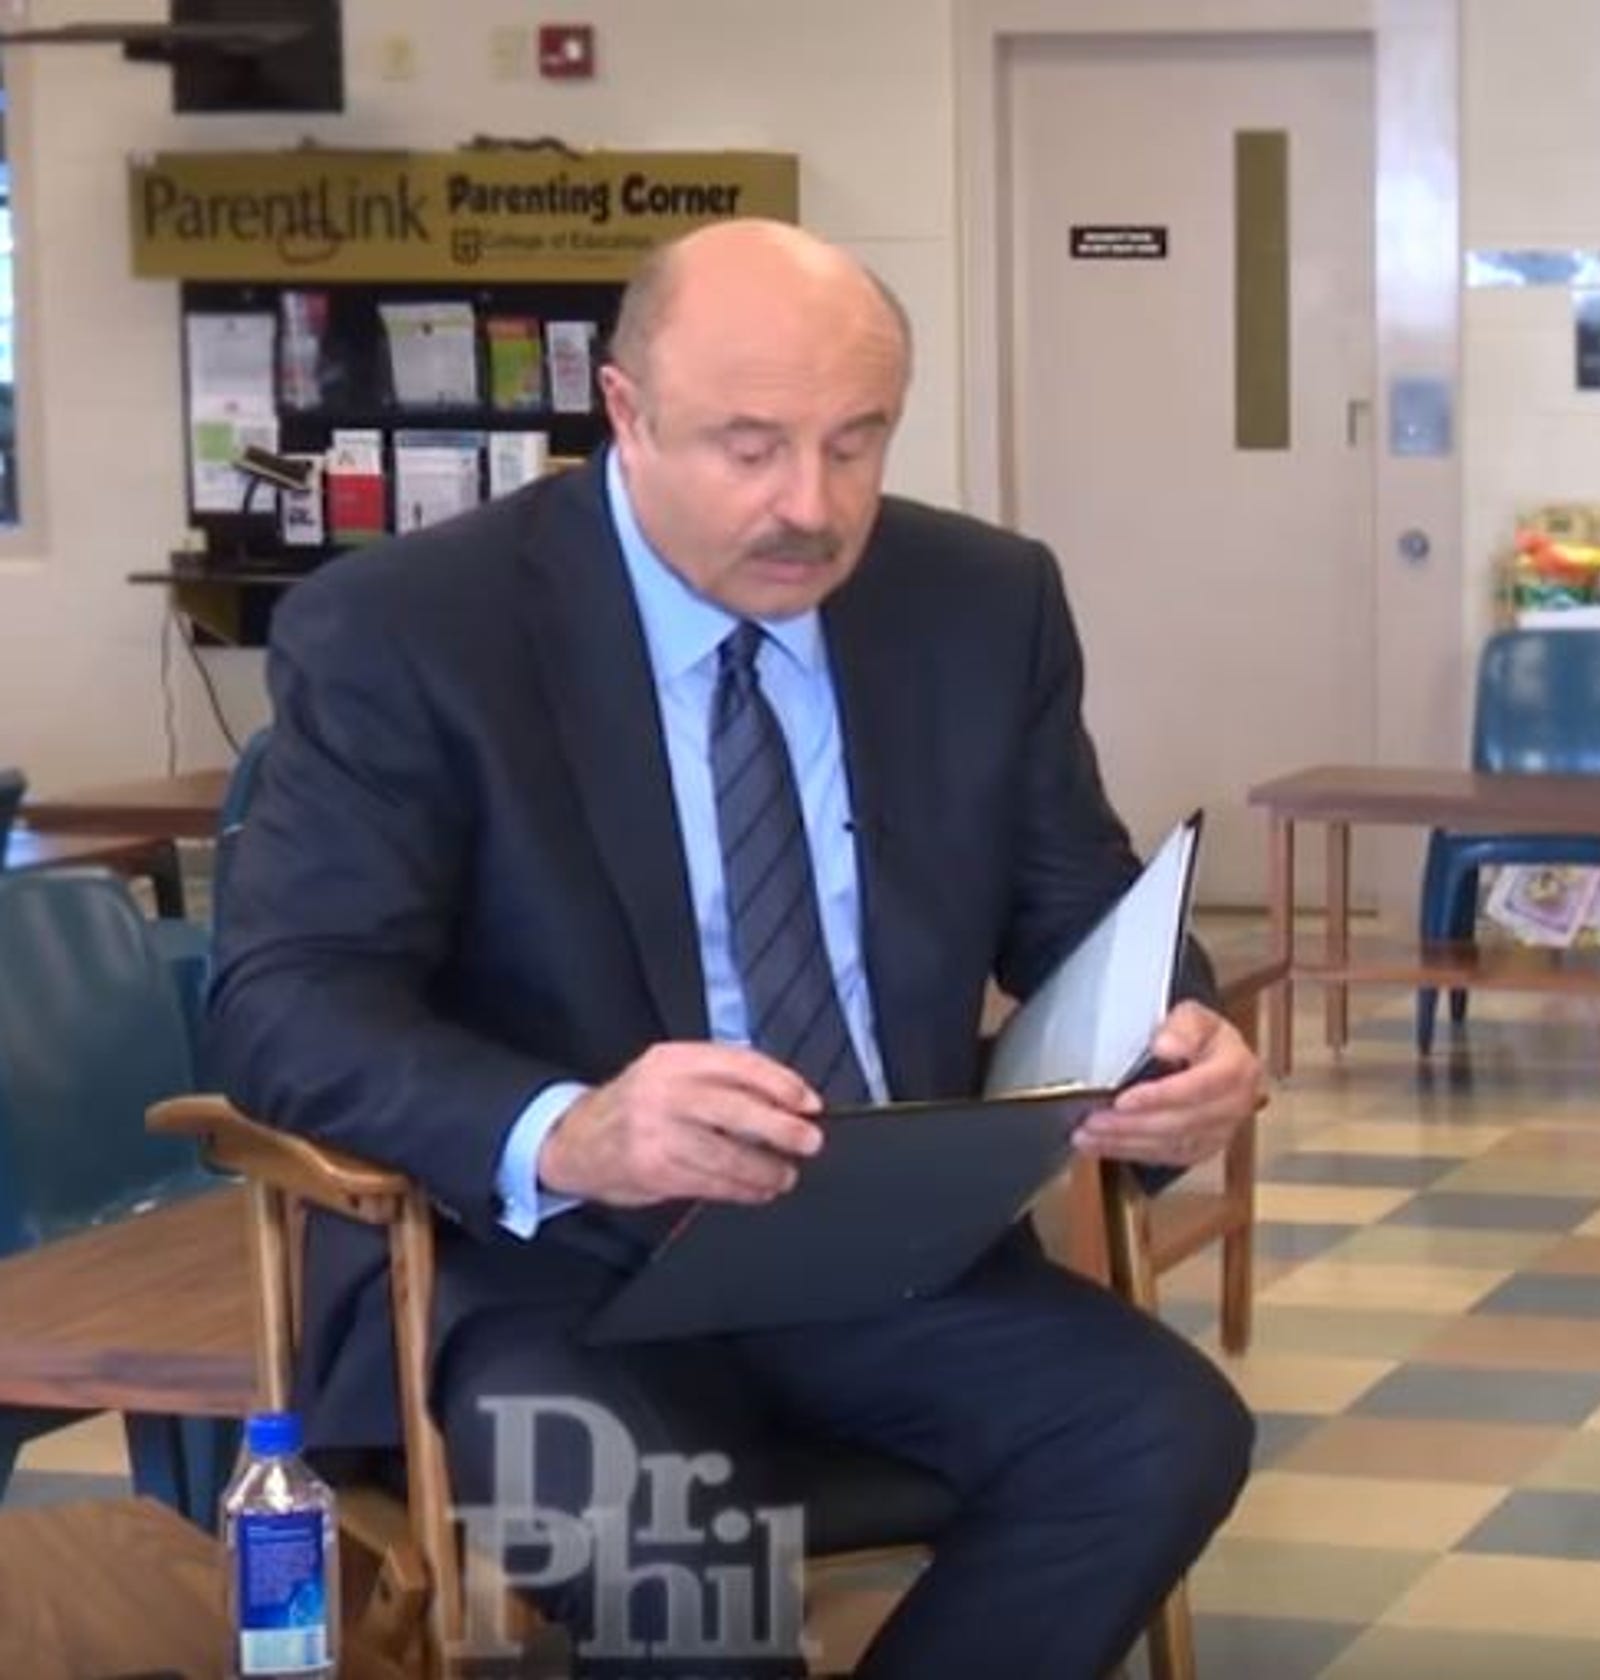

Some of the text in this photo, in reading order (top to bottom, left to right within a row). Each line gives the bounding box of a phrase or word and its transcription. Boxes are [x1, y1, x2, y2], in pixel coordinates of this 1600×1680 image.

[144, 172, 430, 242] ParentLink
[446, 171, 742, 225] Parenting Corner
